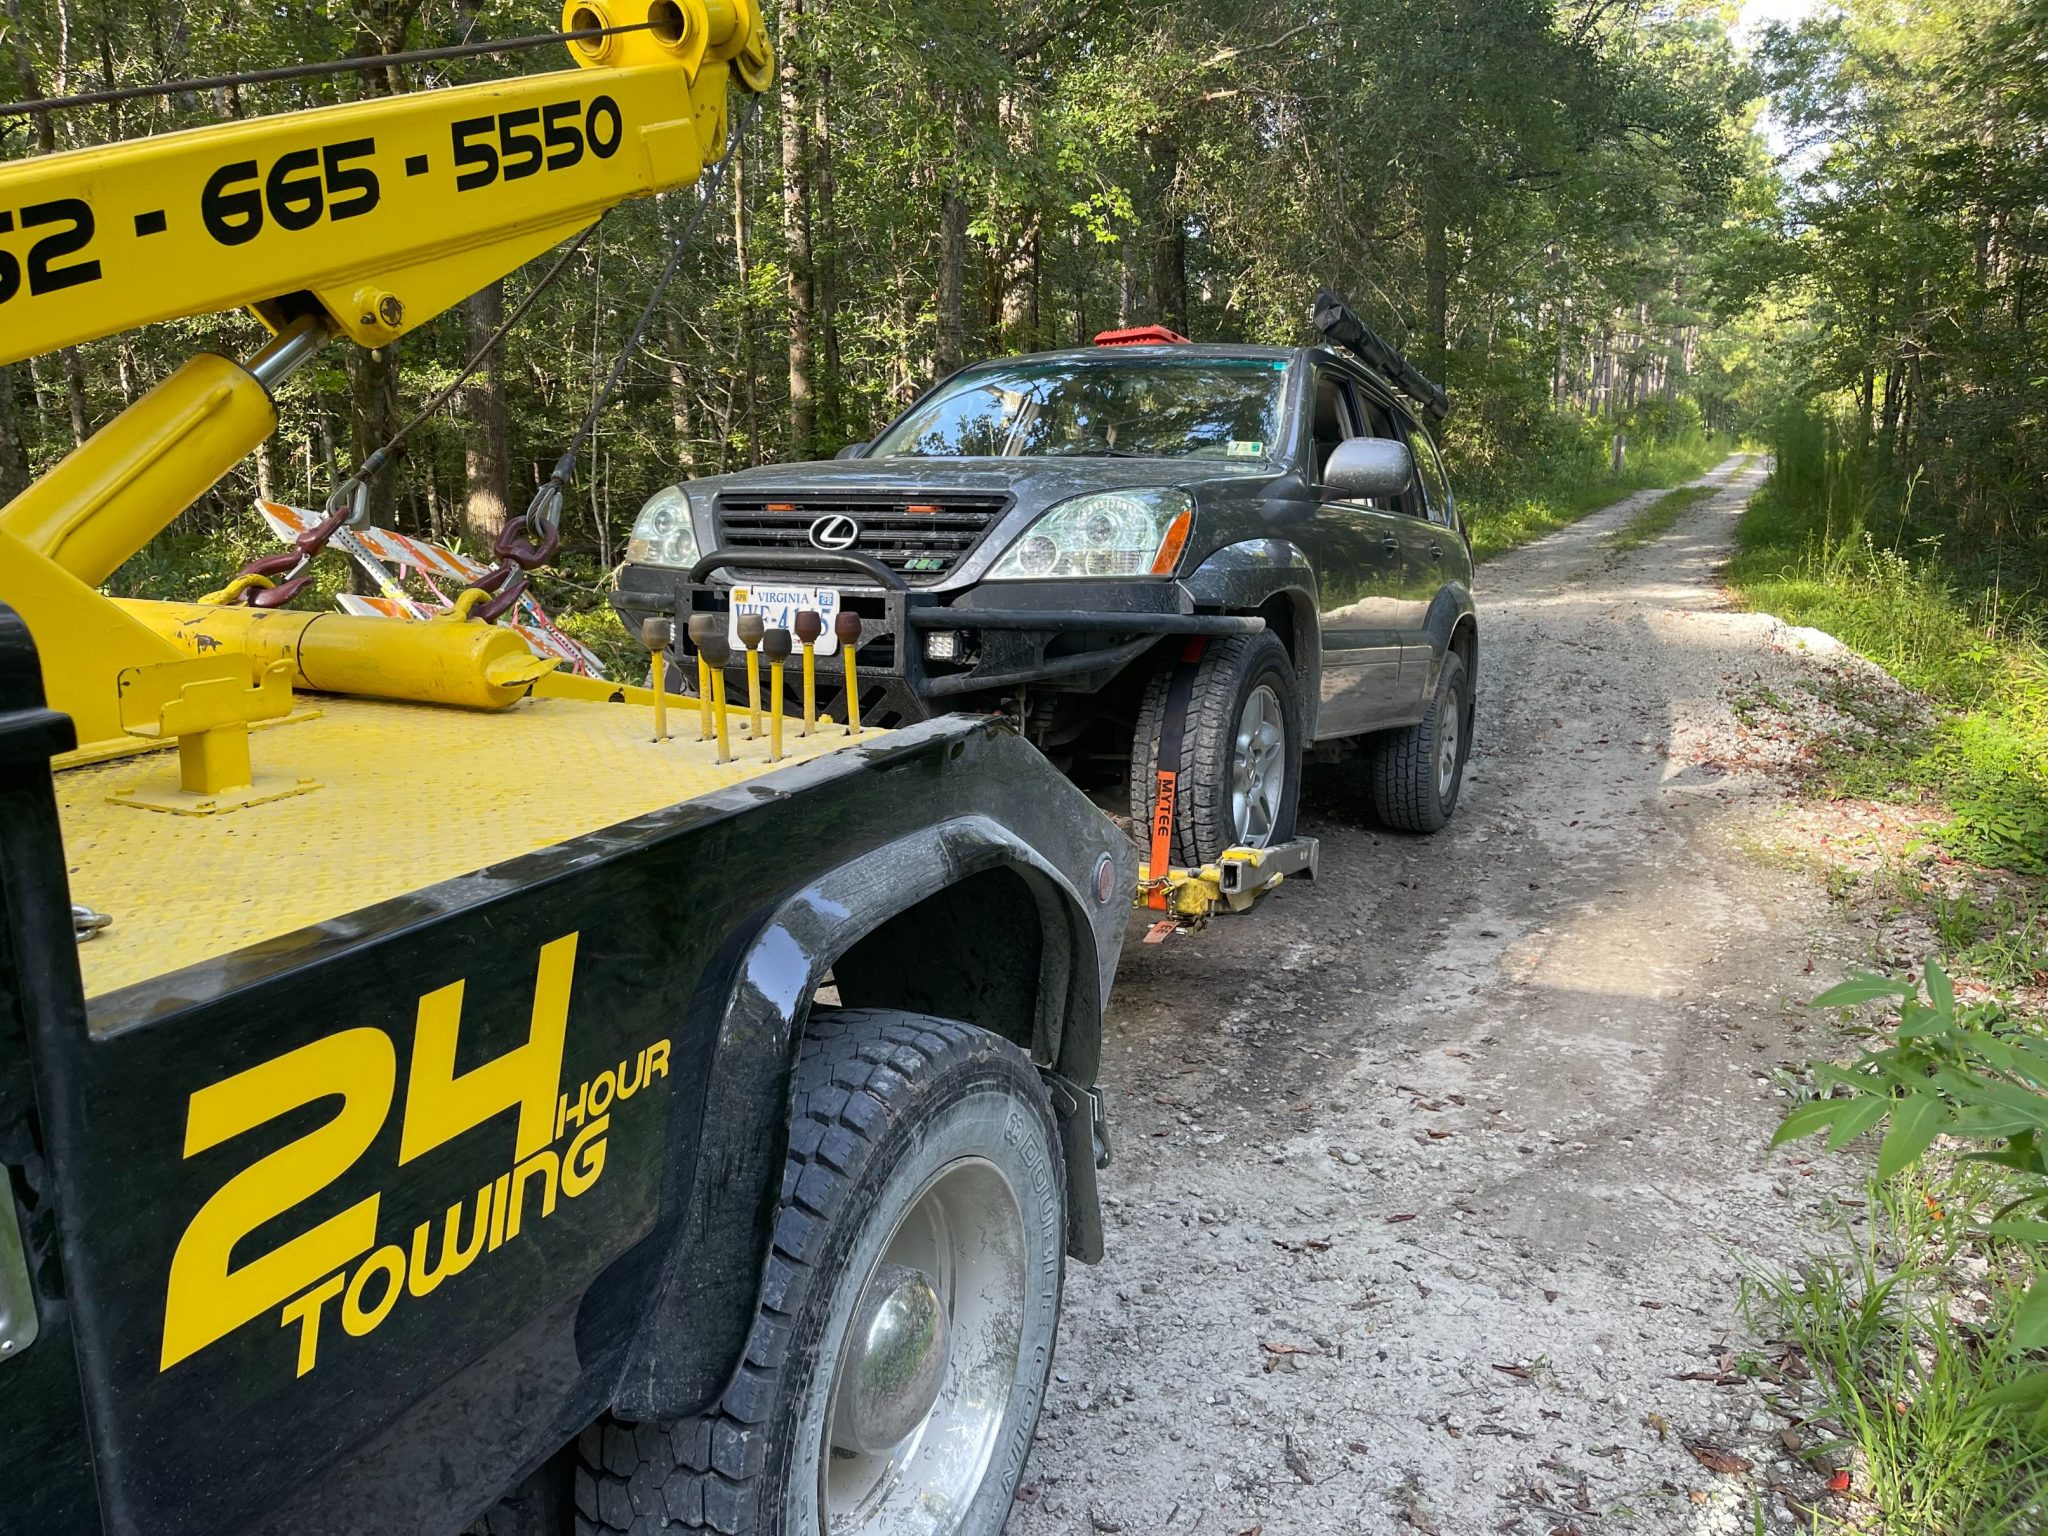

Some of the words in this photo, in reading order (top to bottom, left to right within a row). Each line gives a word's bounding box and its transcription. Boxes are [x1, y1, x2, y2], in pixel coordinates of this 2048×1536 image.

[451, 94, 624, 192] 5550
[758, 592, 809, 604] VIRGINIA
[1158, 779, 1174, 837] MYTEE
[160, 931, 579, 1373] 24
[555, 1038, 672, 1140] HOUR
[281, 1113, 610, 1380] TOWING
